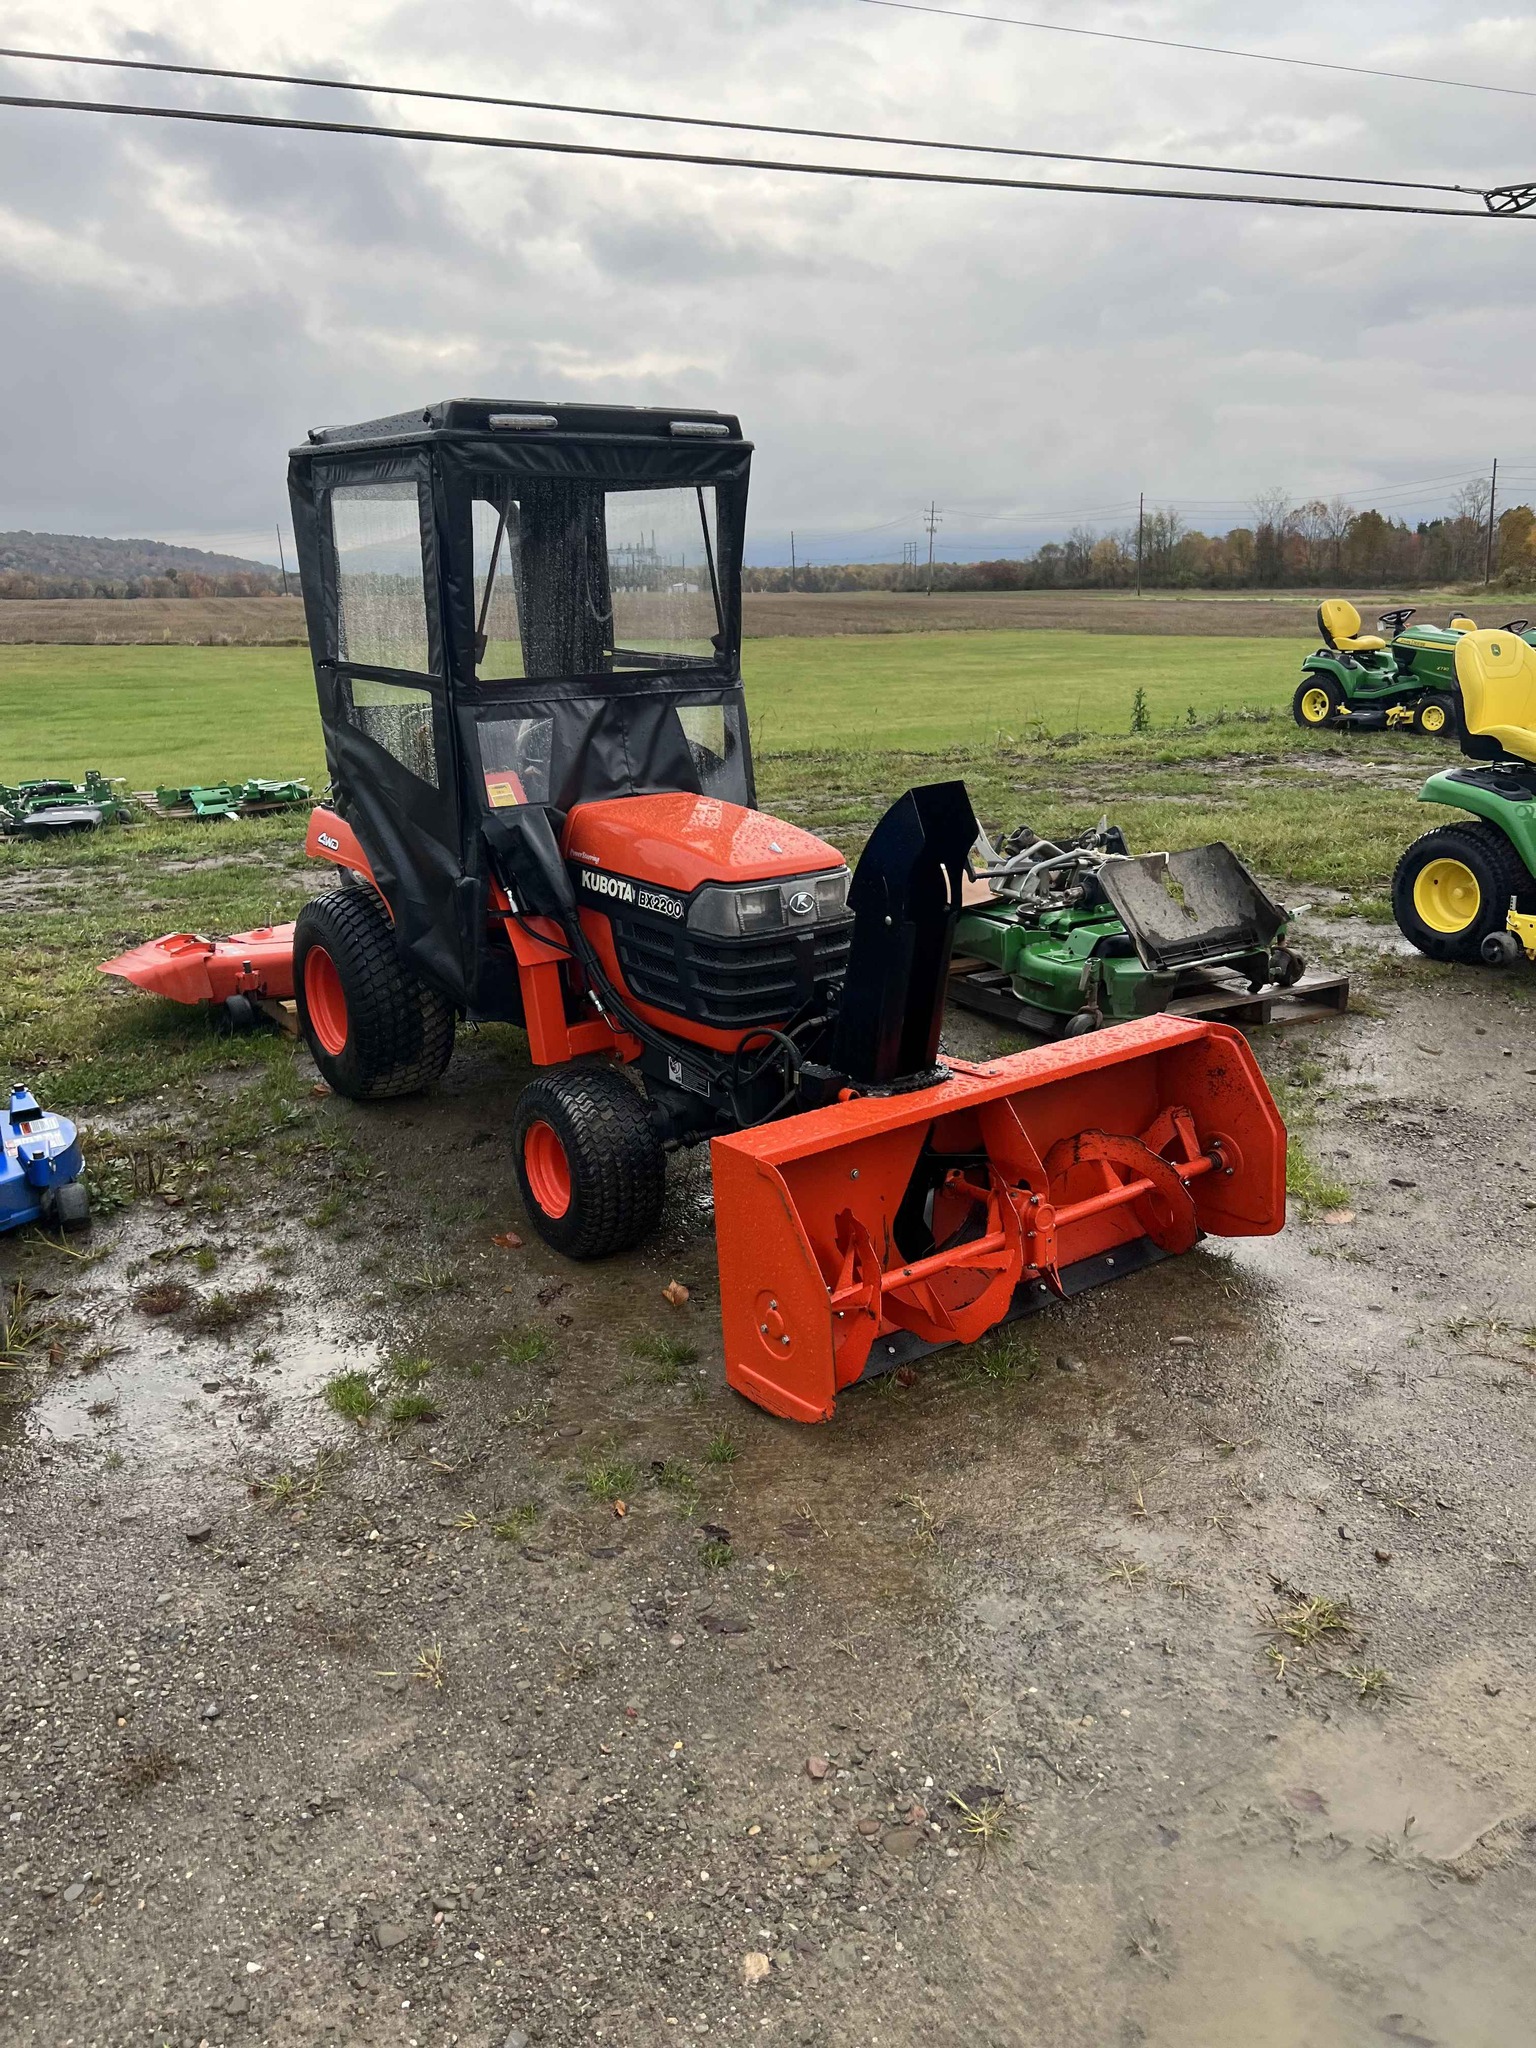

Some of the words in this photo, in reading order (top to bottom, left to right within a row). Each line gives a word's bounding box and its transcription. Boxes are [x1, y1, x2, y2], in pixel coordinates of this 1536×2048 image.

[317, 832, 339, 851] 4WD
[581, 869, 633, 903] KUBOTA
[638, 891, 683, 918] BX2200
